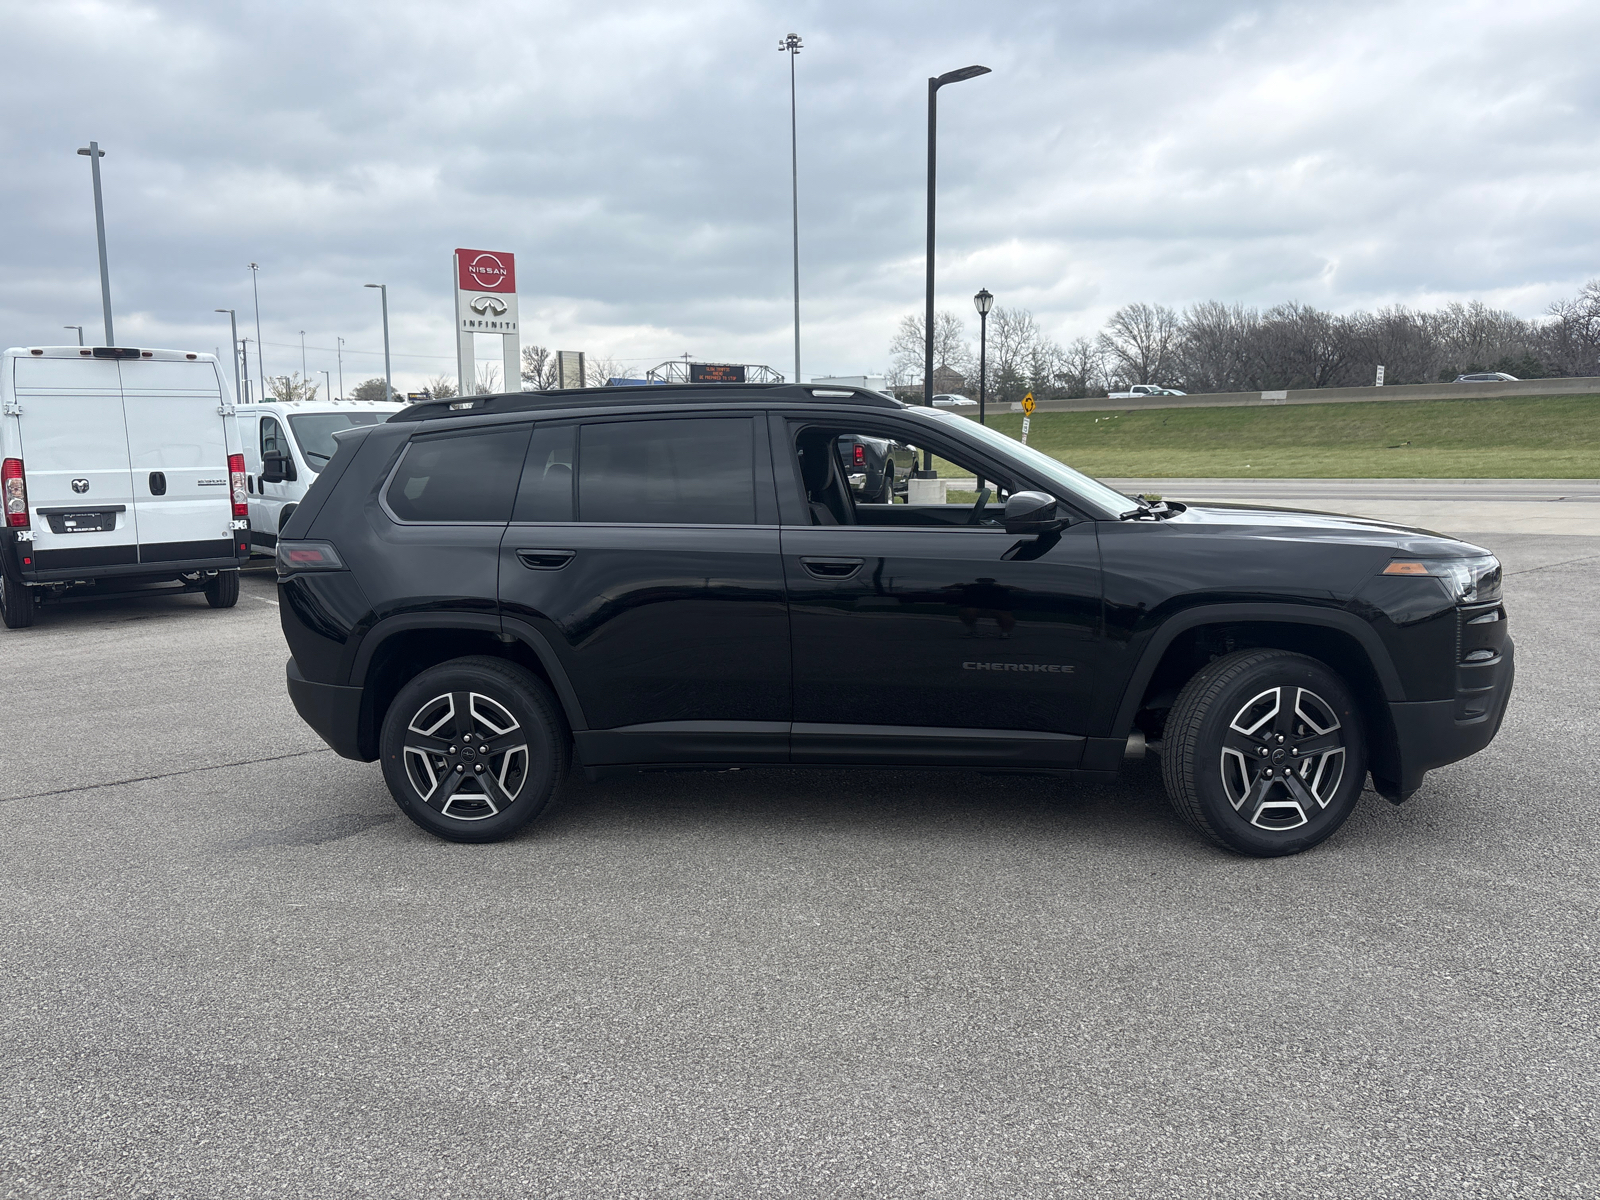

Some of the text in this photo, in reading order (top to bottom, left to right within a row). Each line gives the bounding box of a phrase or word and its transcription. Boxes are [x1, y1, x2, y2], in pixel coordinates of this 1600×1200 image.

[469, 266, 507, 275] NISSAN
[463, 320, 516, 330] INFINITI
[962, 661, 1075, 673] CHEROKEE
